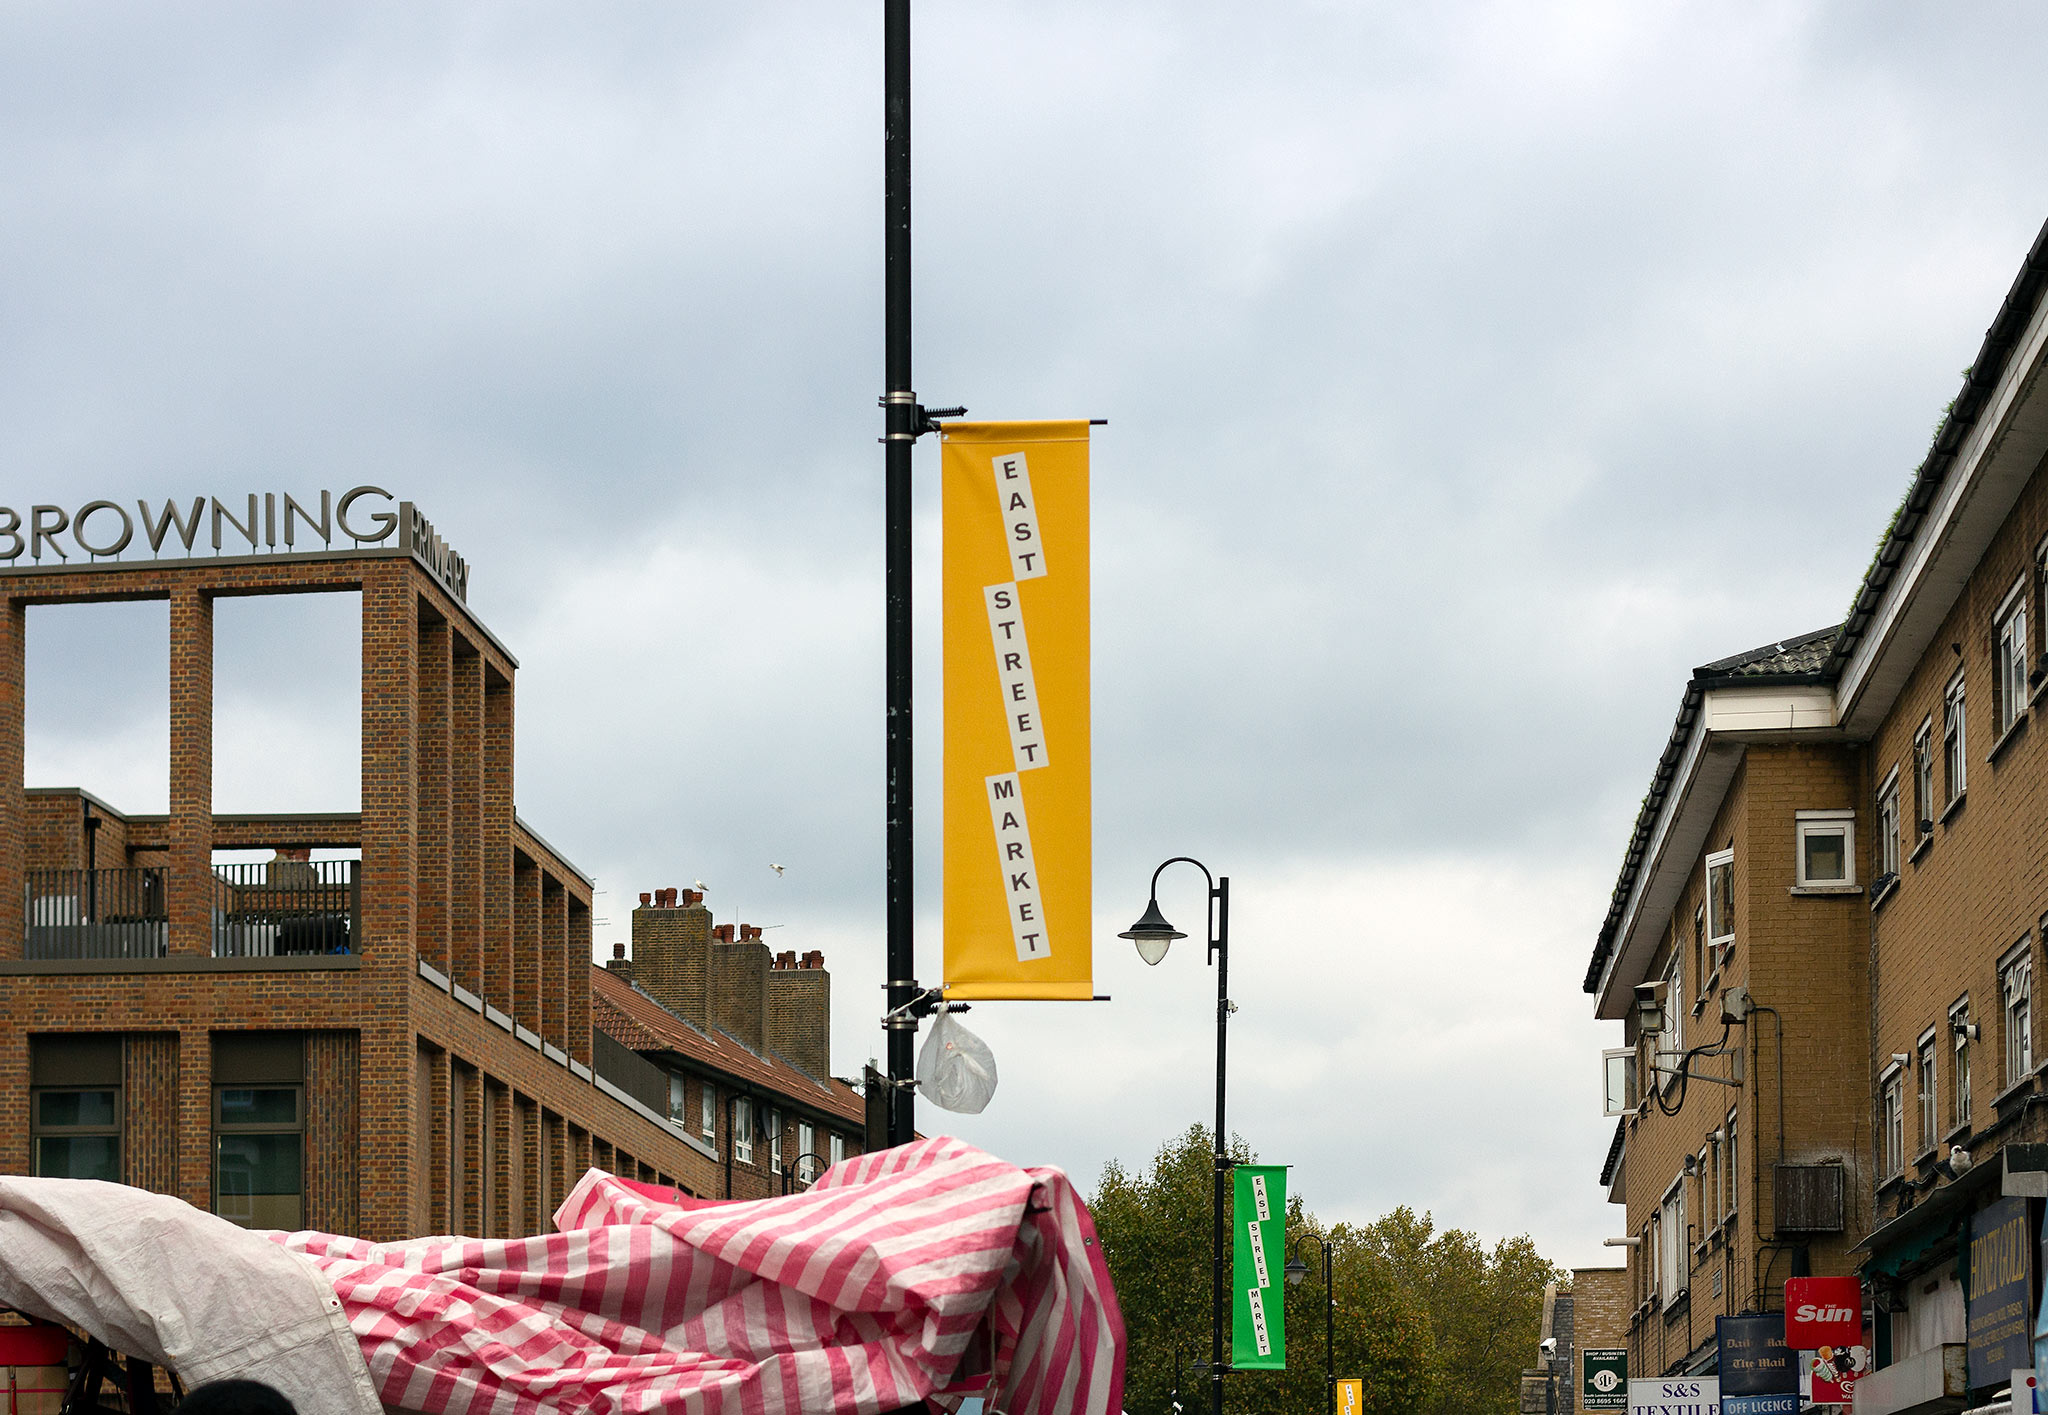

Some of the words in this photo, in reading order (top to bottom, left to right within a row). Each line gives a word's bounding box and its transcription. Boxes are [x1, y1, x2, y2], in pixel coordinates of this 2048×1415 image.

[0, 486, 398, 560] BROWNING
[1003, 461, 1036, 571] EAST
[994, 591, 1038, 762] STREET
[993, 780, 1040, 952] MARKET
[1255, 1178, 1267, 1218] EAST
[1251, 1224, 1268, 1286] STREET
[1250, 1291, 1268, 1353] MARKET
[1794, 1304, 1853, 1322] Sun
[1662, 1383, 1700, 1398] S&S
[1732, 1359, 1754, 1368] The
[1758, 1357, 1786, 1367] Mail
[1728, 1403, 1748, 1414] OFF
[1751, 1400, 1793, 1413] LICENCE
